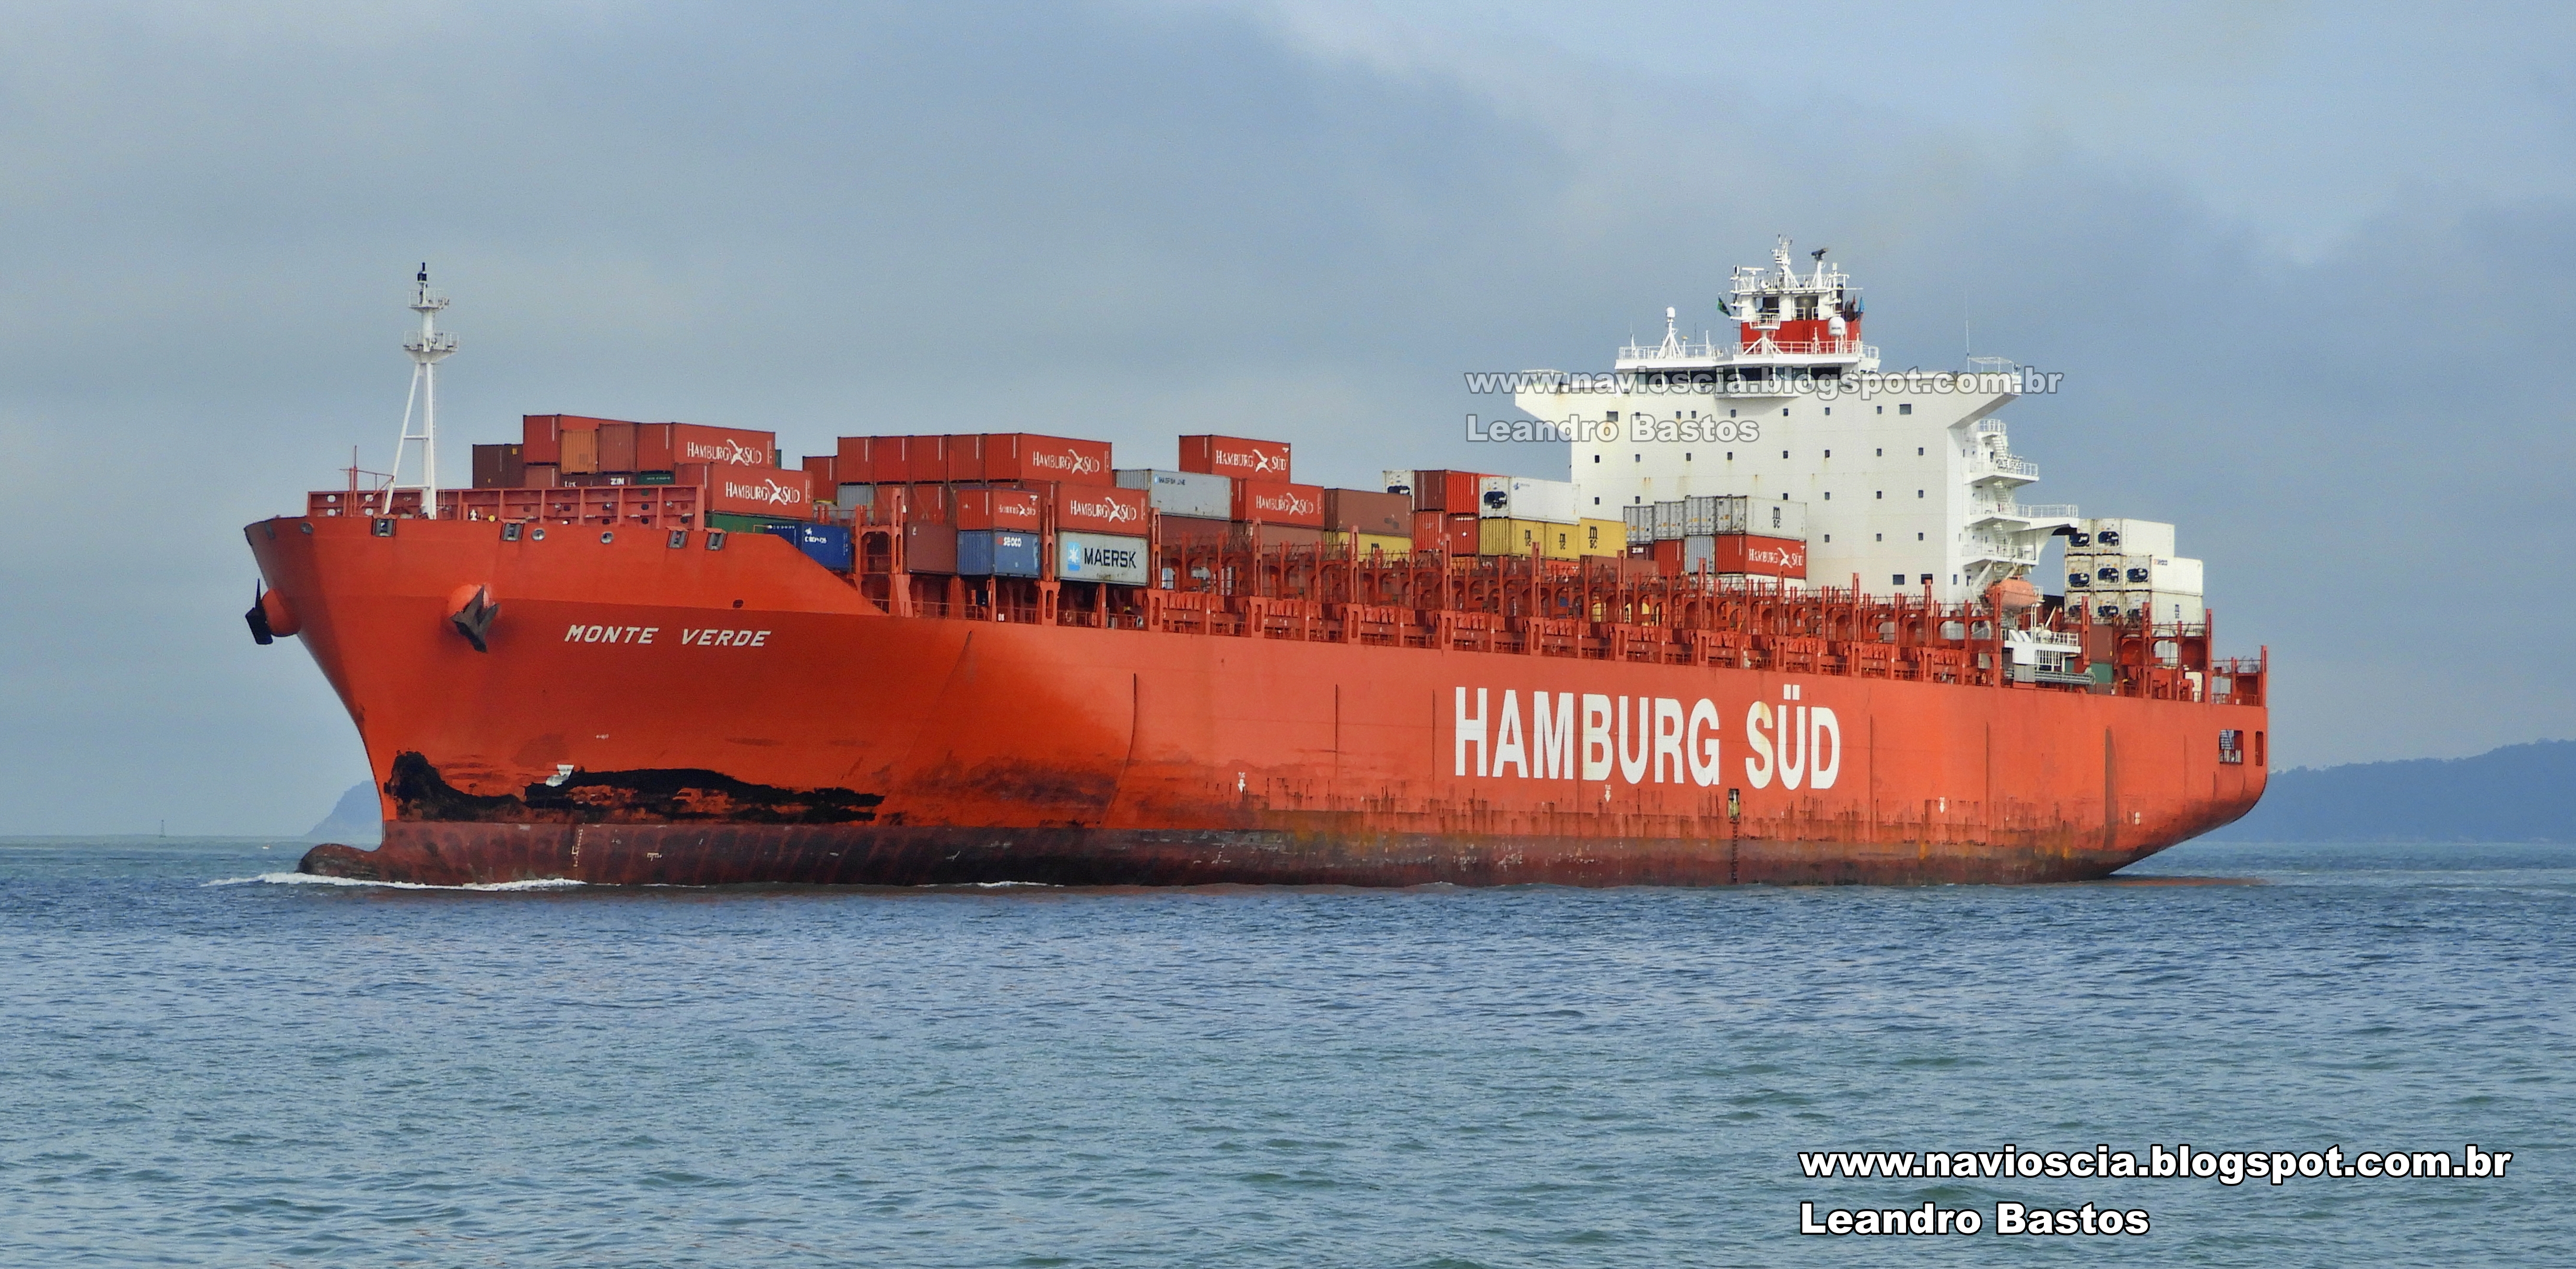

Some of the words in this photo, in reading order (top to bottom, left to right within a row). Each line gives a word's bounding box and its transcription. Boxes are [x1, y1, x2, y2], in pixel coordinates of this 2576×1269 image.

[687, 441, 730, 461] HAMBURG
[1033, 451, 1071, 469] HAMBURG
[1216, 450, 1253, 467] HAMBURG
[1272, 455, 1286, 471] SÜD
[726, 481, 769, 501] HAMBURG
[1071, 500, 1108, 518] HAMBURG
[1084, 548, 1137, 568] MAERSK
[564, 624, 659, 644] MONTE
[681, 628, 771, 647] VERDE
[1455, 686, 1720, 787] HAMBURG
[1745, 684, 1841, 790] SÜD
